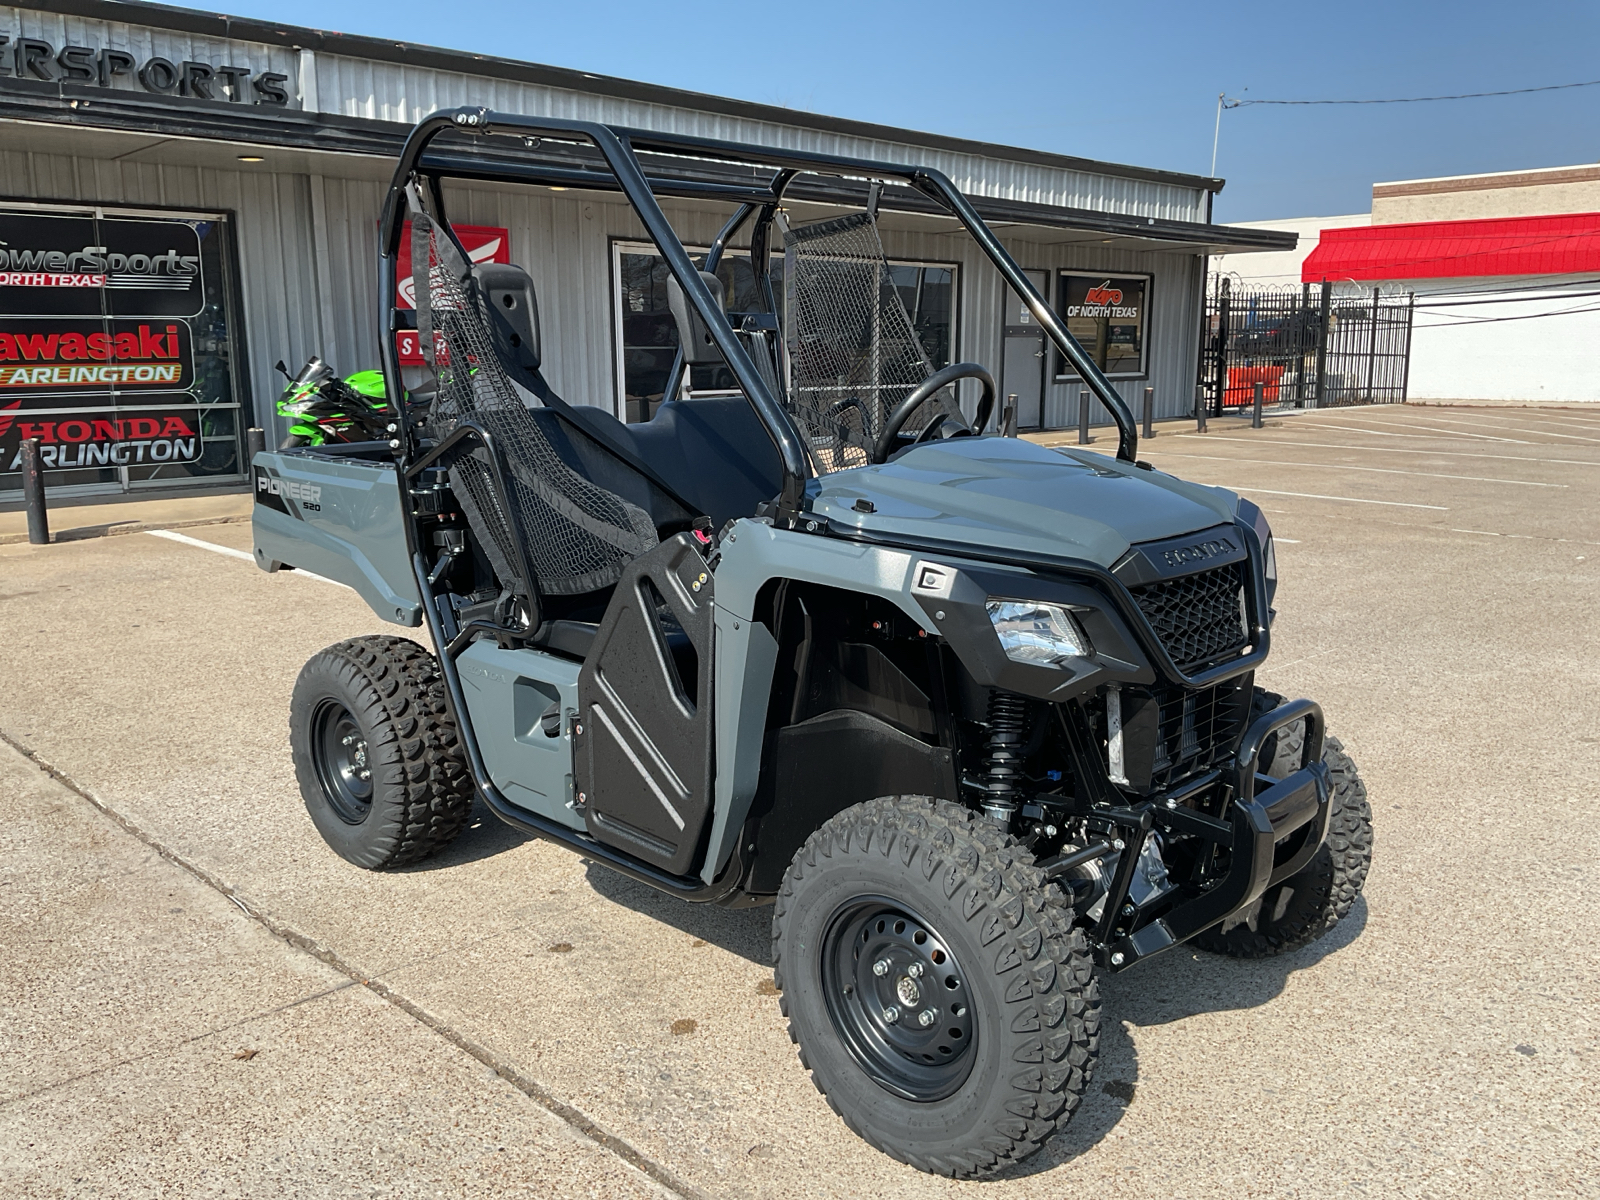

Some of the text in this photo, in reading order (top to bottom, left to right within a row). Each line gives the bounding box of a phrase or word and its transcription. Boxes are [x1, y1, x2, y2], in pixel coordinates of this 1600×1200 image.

[48, 274, 103, 287] TEXAS
[1067, 305, 1137, 317] OF NORTH TEXAS
[8, 366, 174, 384] ARLINGTON
[16, 416, 195, 443] HONDA
[257, 476, 322, 503] PIONEER
[302, 501, 321, 512] 520
[1160, 538, 1238, 567] HONDA
